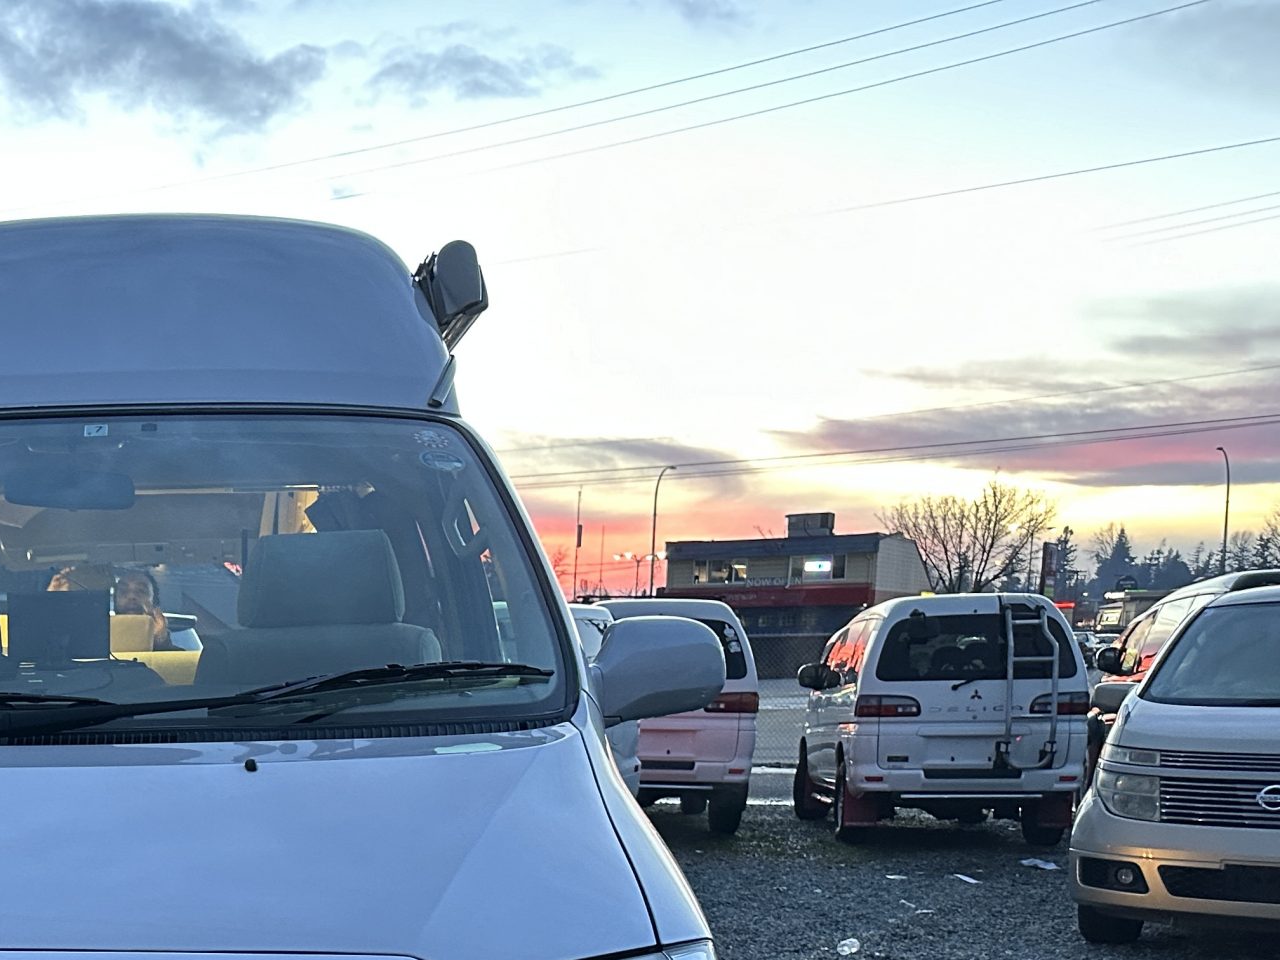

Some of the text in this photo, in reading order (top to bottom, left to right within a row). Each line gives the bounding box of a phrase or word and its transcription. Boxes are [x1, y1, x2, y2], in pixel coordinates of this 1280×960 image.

[746, 576, 801, 587] NOW ON
[928, 704, 1023, 713] DELICA
